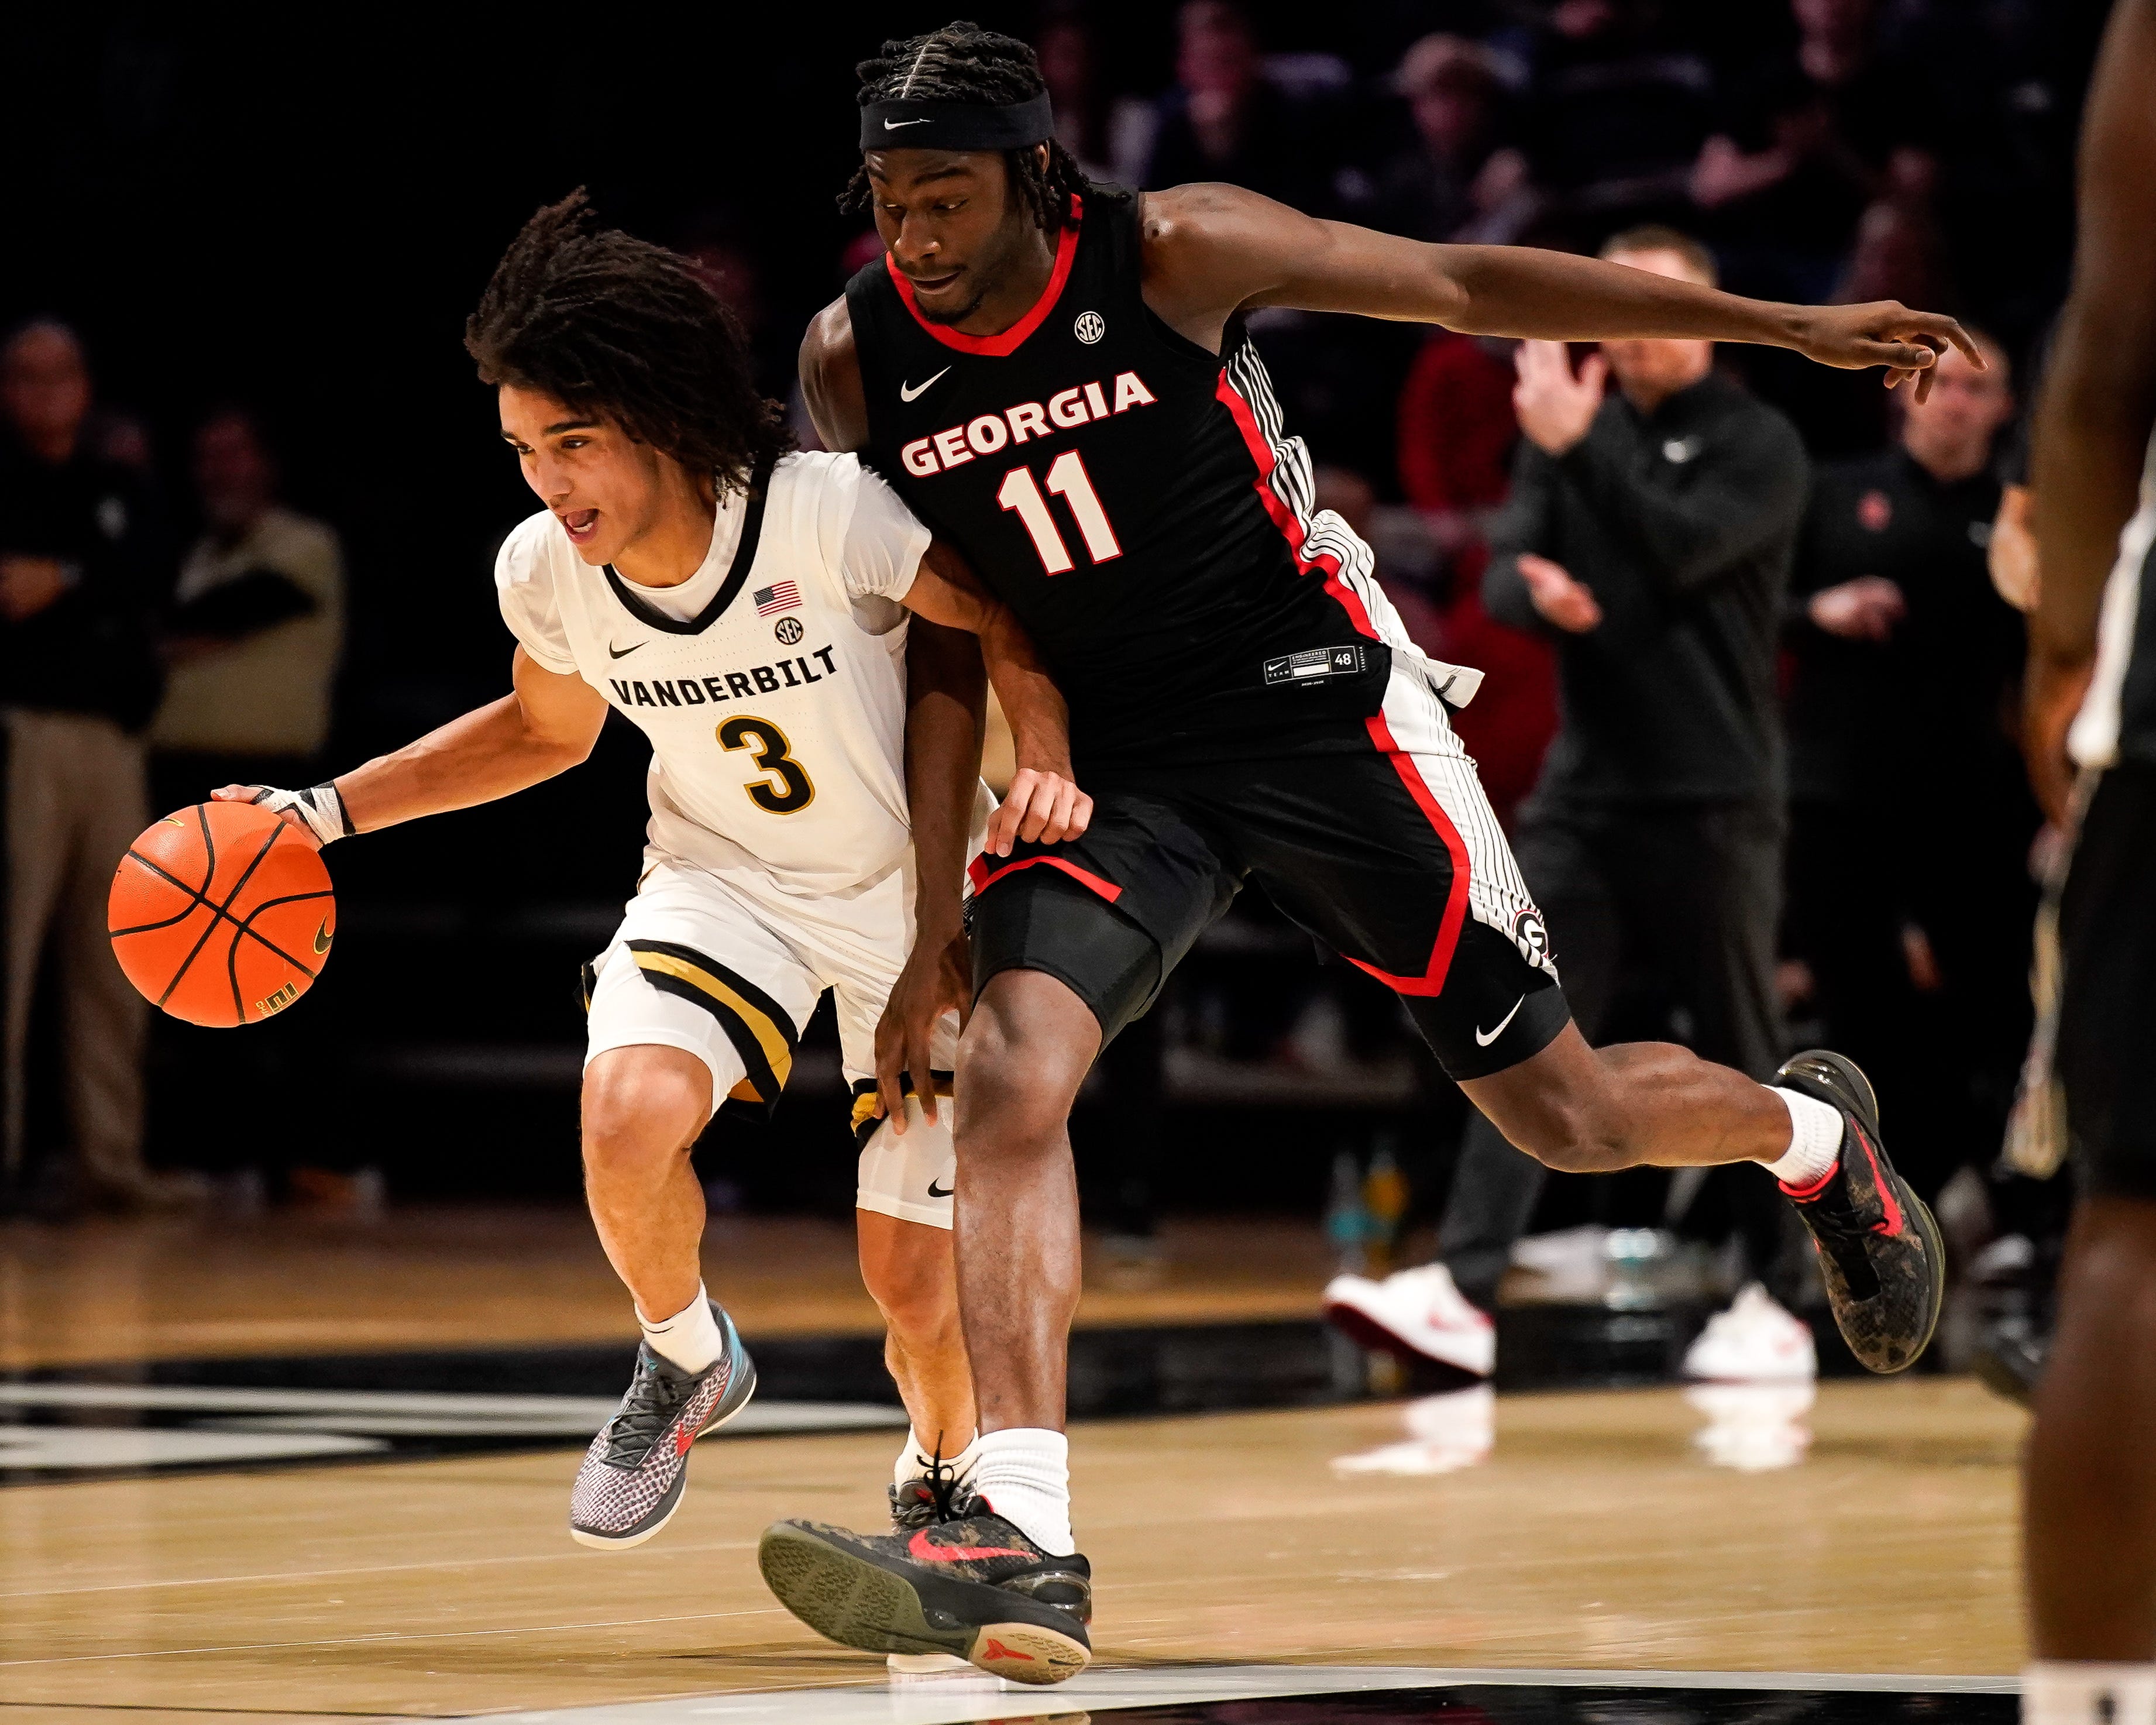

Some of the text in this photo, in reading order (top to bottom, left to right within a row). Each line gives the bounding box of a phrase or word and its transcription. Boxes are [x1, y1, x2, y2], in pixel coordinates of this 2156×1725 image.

[1077, 314, 1102, 341] SEC
[901, 370, 1158, 477] GEORGIA
[996, 449, 1123, 576] 11
[776, 619, 802, 644] SEC
[608, 644, 838, 707] VANDERBILT
[1335, 653, 1352, 665] 48
[716, 714, 816, 815] 3
[1523, 918, 1547, 948] G
